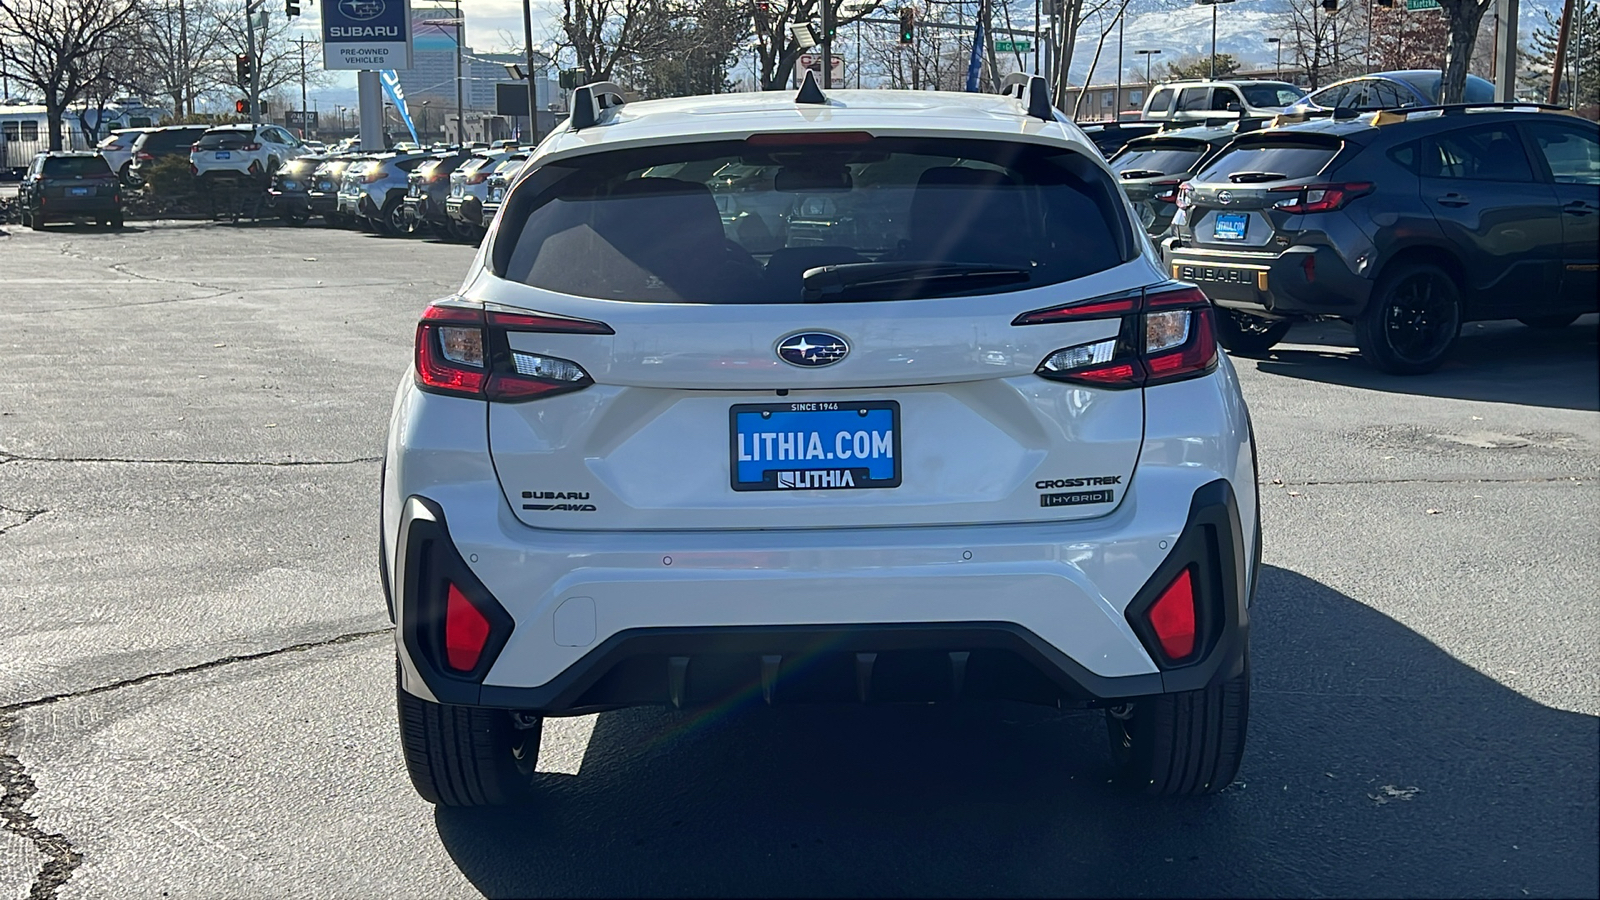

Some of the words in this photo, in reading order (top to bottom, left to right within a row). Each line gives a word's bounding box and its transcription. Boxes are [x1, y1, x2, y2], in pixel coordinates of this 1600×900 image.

[330, 26, 398, 37] SUBARU
[1183, 267, 1252, 284] SUBARU
[791, 403, 817, 411] SINCE
[819, 403, 838, 411] 1946
[738, 430, 893, 461] LITHIA.COM
[795, 470, 855, 488] LITHIA
[1035, 475, 1122, 489] CROSSTREK
[522, 491, 590, 500] SUBARU
[1053, 494, 1102, 504] HYBRID
